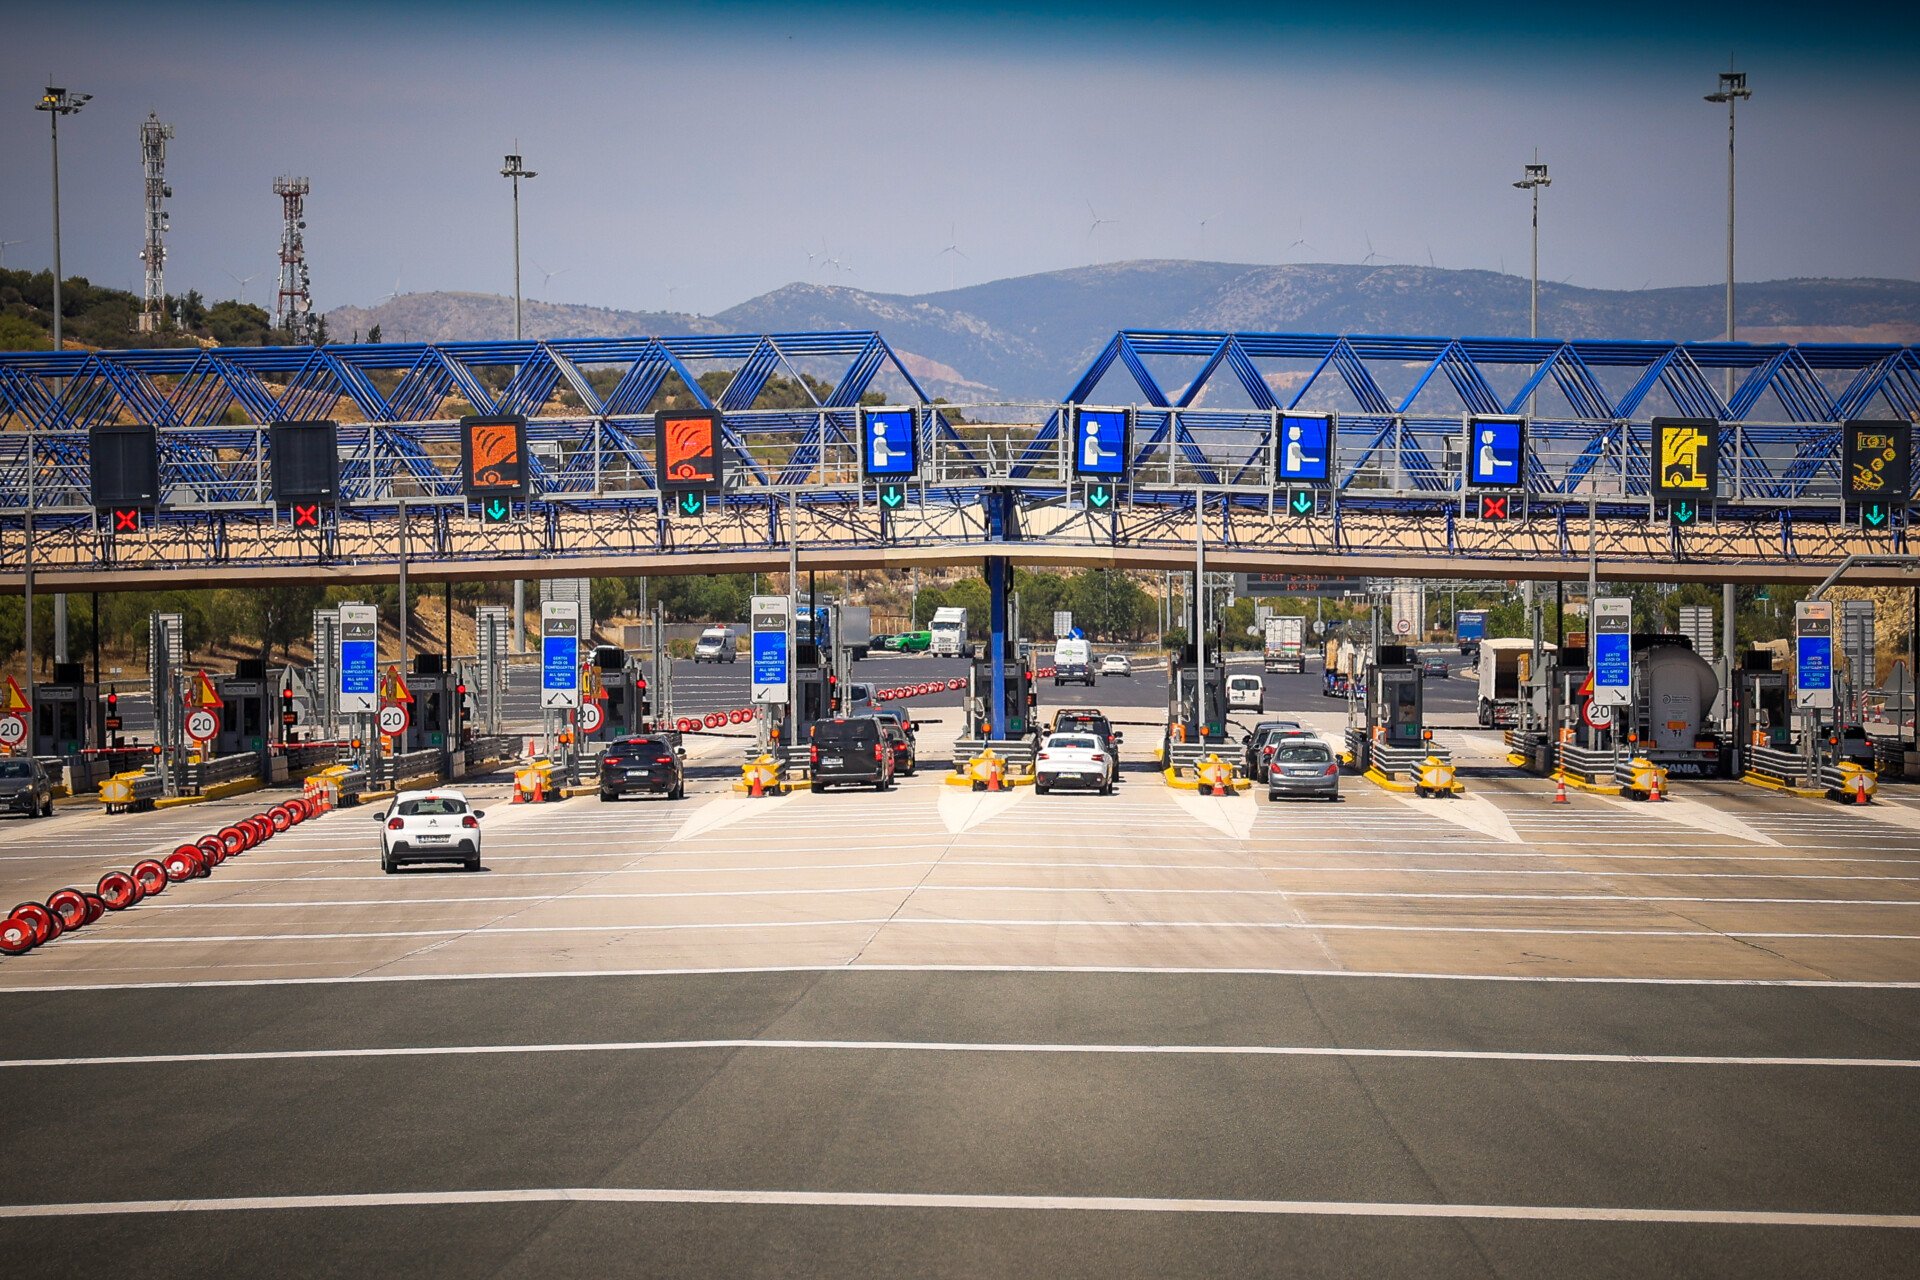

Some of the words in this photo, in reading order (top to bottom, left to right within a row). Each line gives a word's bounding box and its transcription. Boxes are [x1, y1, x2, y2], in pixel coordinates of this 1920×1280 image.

[382, 712, 401, 726] 20
[1590, 707, 1609, 718] 20
[1, 722, 20, 736] 20
[192, 718, 211, 731] 20
